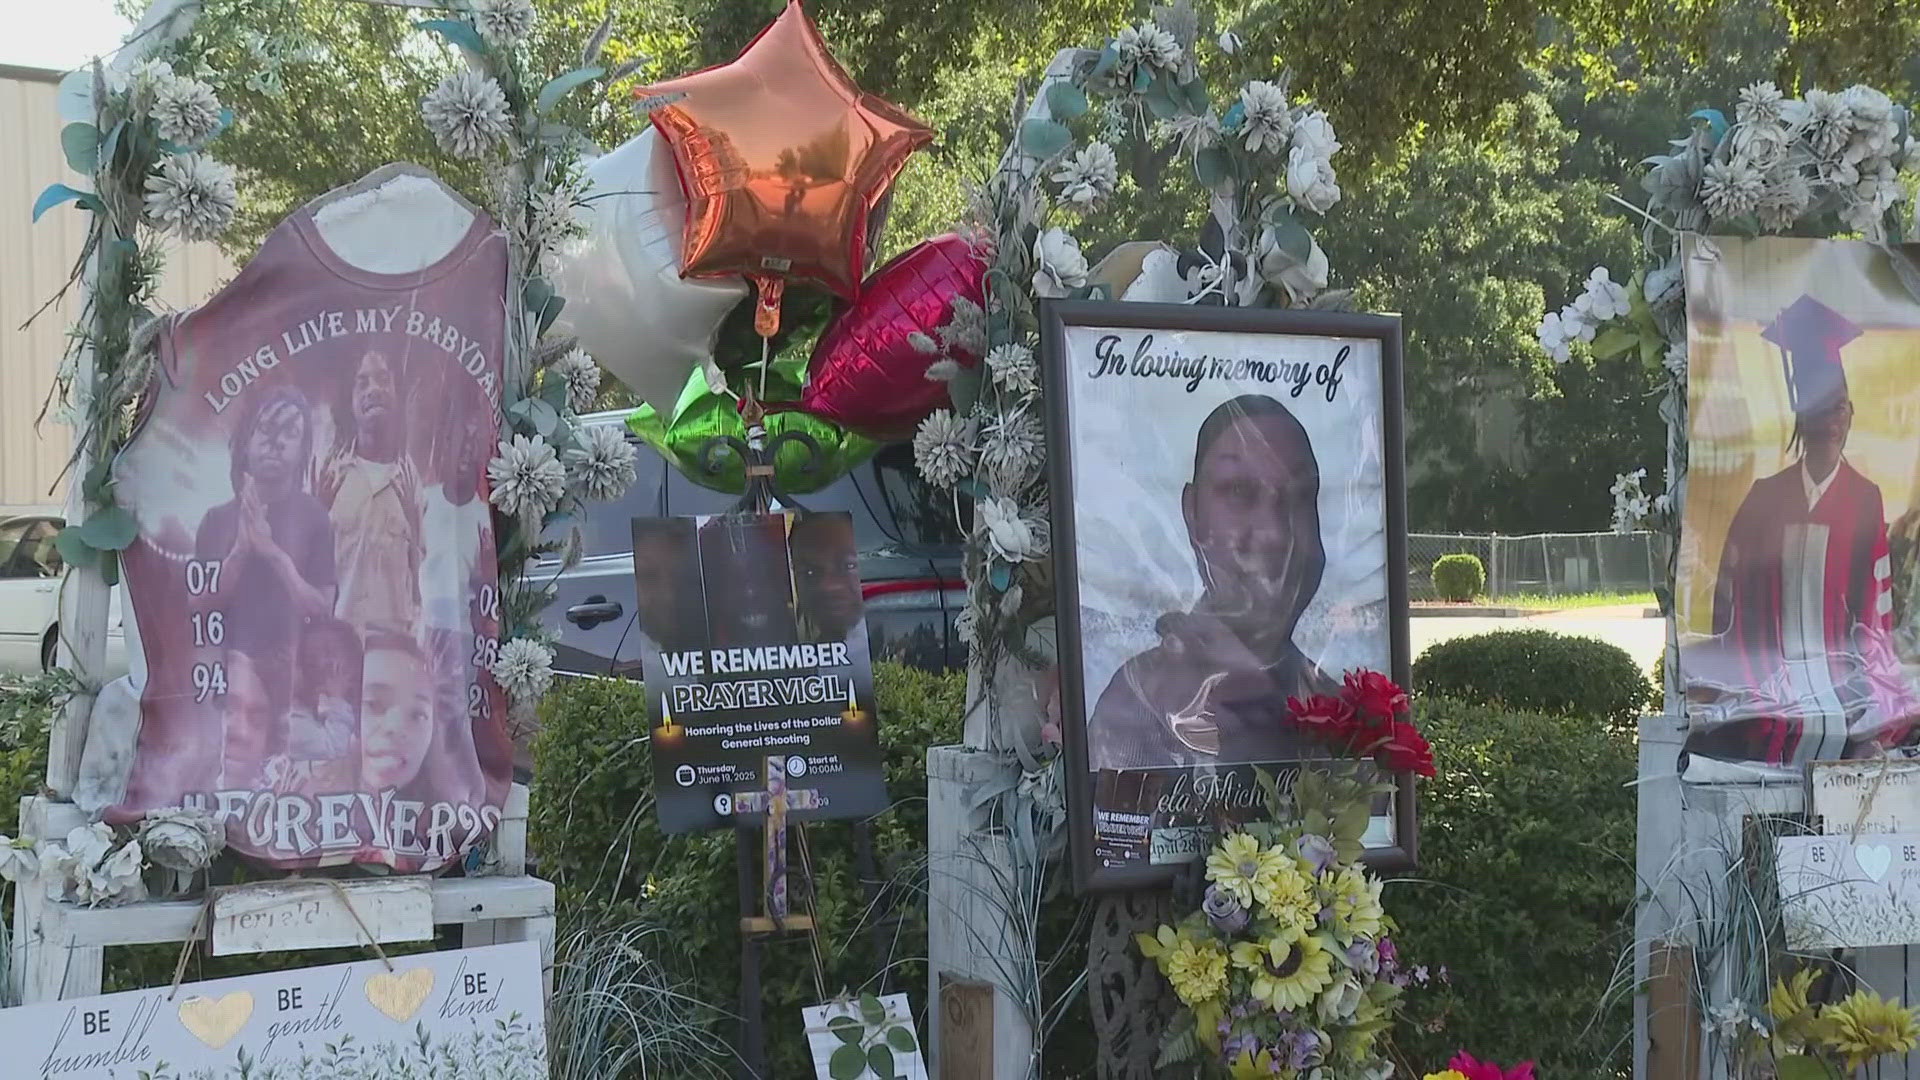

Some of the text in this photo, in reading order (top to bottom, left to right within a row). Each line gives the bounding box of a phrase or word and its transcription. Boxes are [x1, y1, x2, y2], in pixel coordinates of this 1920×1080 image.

[204, 345, 279, 414] LONG
[281, 311, 347, 357] LIVE
[354, 305, 403, 334] MY
[1088, 334, 1350, 402] In loving memory of
[187, 561, 221, 595] 07
[191, 611, 224, 646] 16
[473, 634, 499, 671] 26
[660, 642, 851, 677] WE REMEMBER
[192, 663, 227, 702] 94
[673, 675, 848, 713] PRAYER VIGIL
[685, 716, 842, 737] Honoring the Lives of the Dollar
[721, 733, 811, 750] General Shooting
[696, 764, 737, 775] Thursday
[807, 755, 838, 765] Start at
[698, 771, 756, 785] June 19, 2025
[1098, 811, 1149, 824] WE REMEMBER
[1812, 847, 1825, 862] BE
[1903, 846, 1916, 861] BE
[278, 986, 303, 1012] BE
[438, 956, 505, 1020] kind
[463, 972, 488, 996] BE
[83, 1009, 110, 1036] BE
[260, 966, 353, 1064] gentle
[39, 994, 164, 1078] humble
